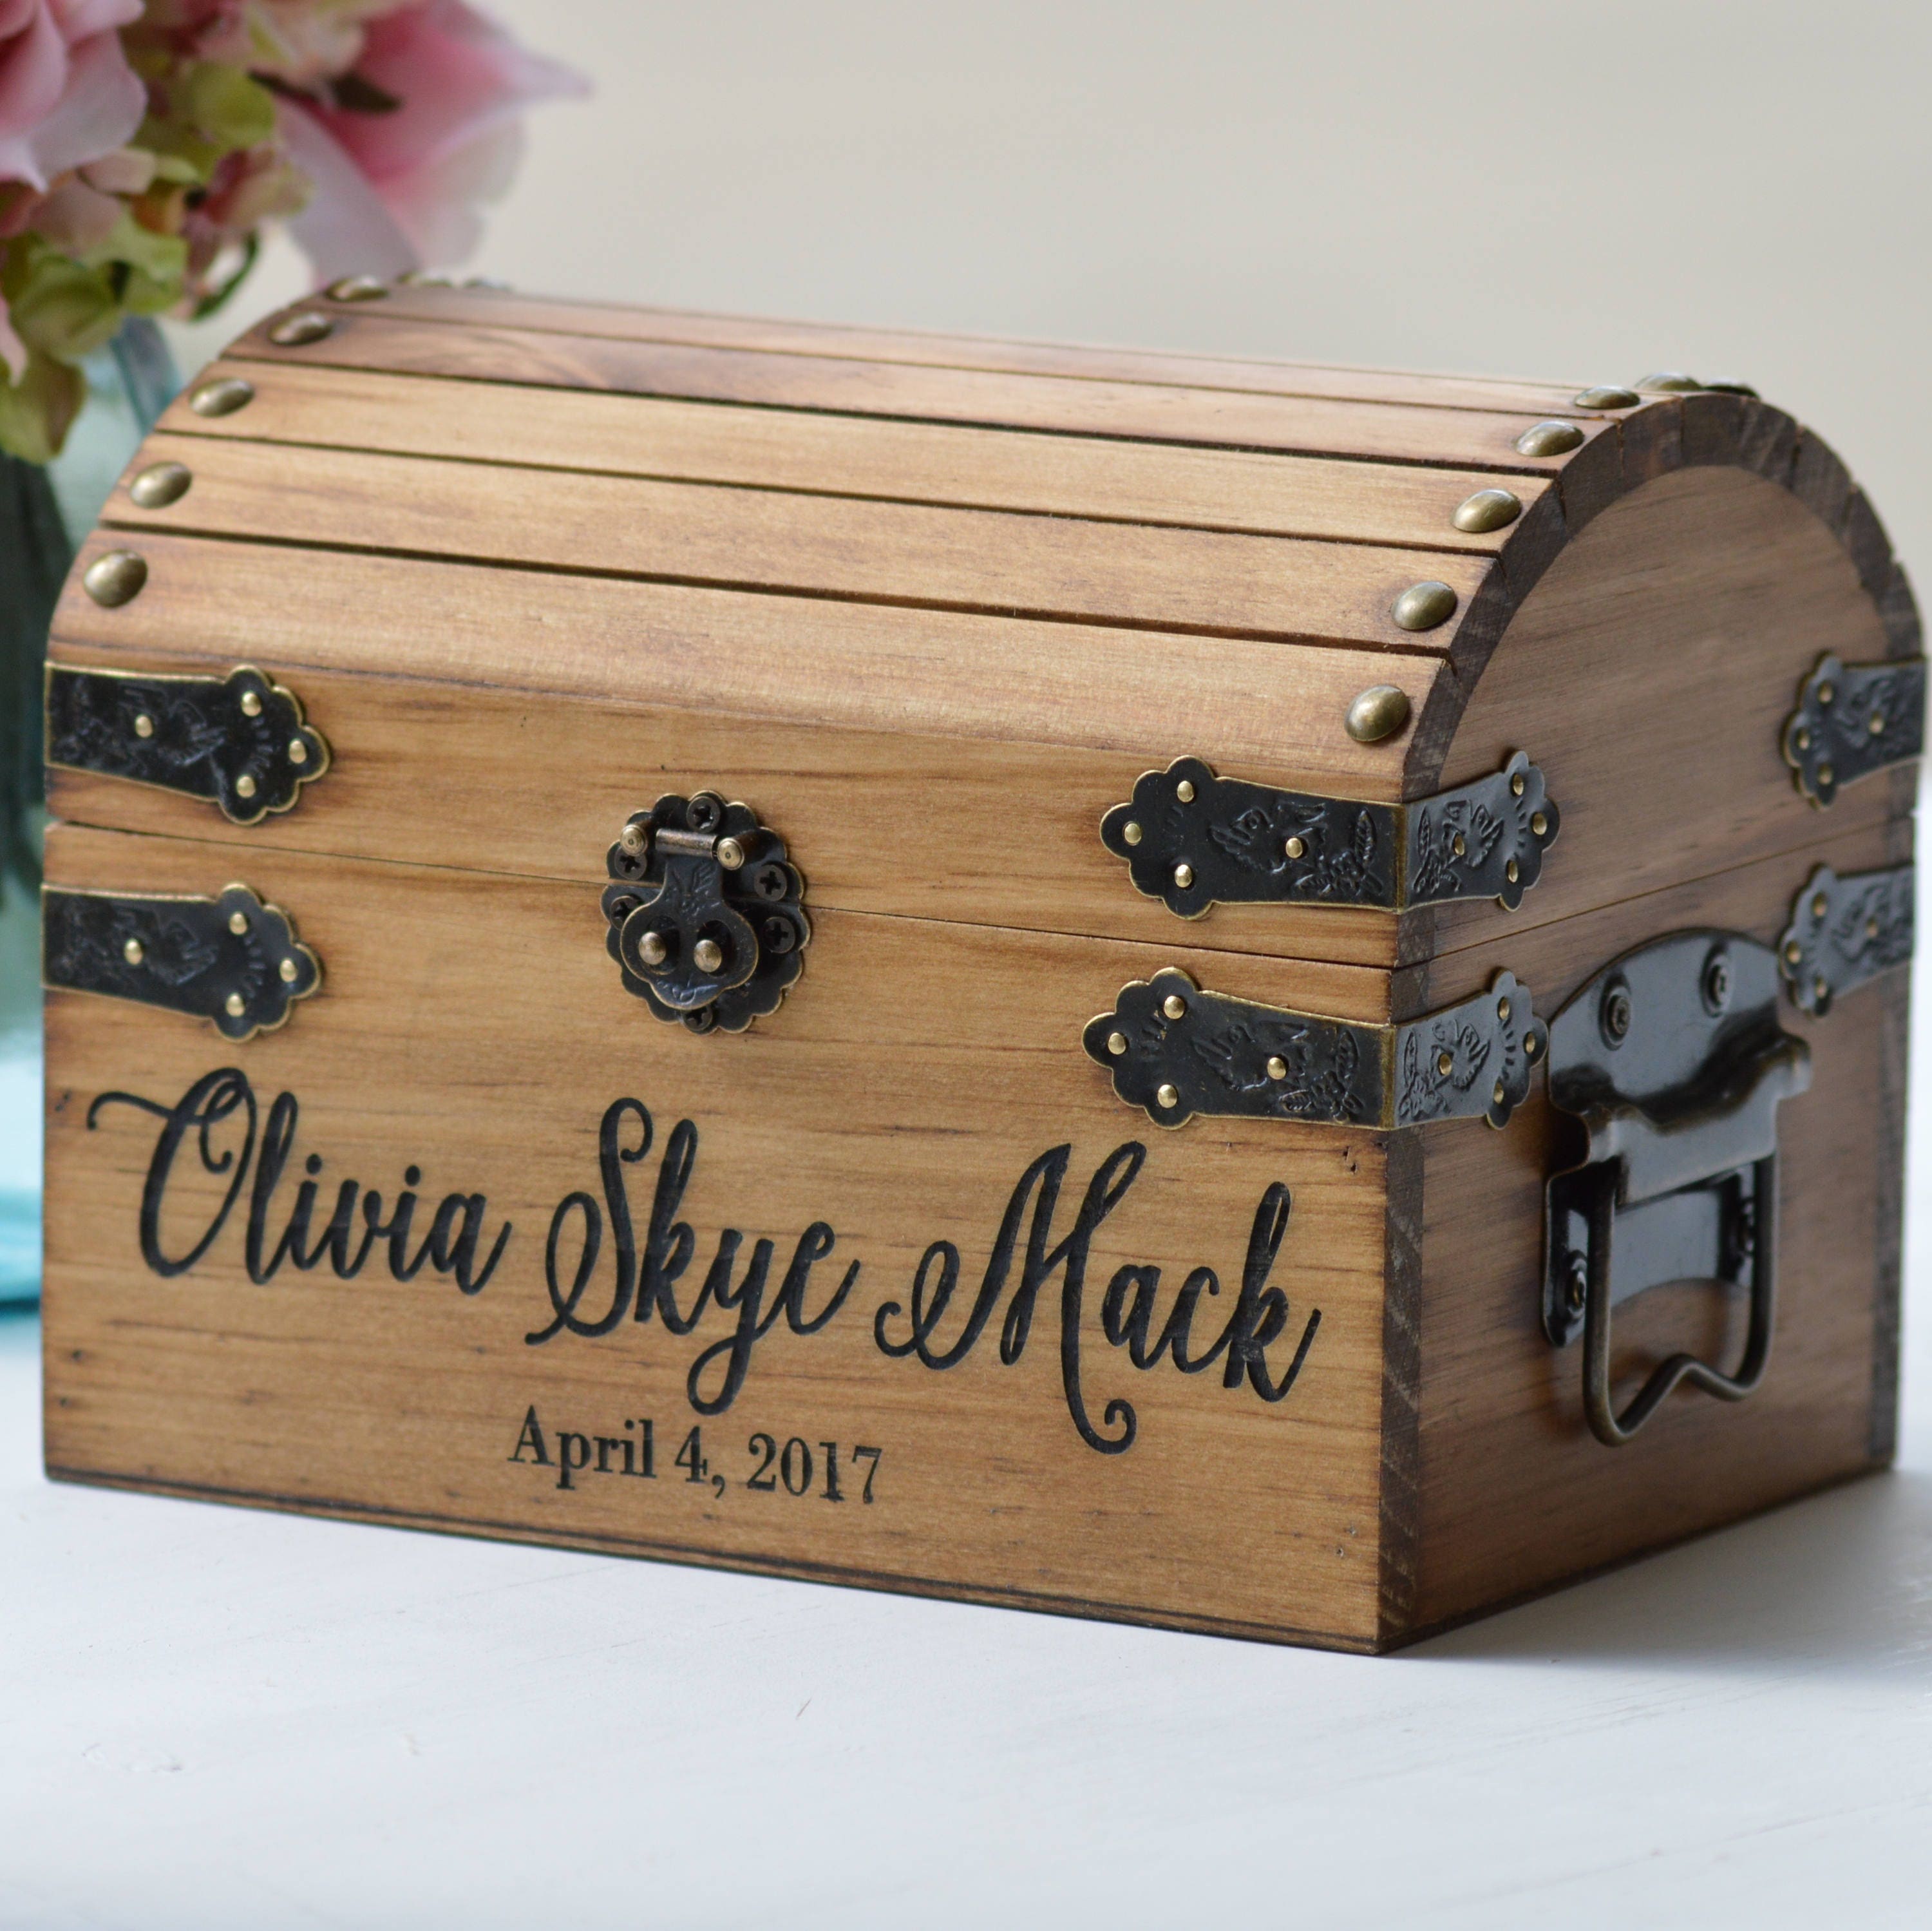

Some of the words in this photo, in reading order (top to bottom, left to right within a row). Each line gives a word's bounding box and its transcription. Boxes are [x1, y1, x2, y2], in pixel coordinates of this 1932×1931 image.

[86, 1067, 513, 1295] Olivia
[524, 1096, 862, 1416] Skye
[873, 1139, 1323, 1456] Mack
[507, 1404, 657, 1491] April
[674, 1425, 726, 1499] 4,
[746, 1432, 883, 1504] 2017
